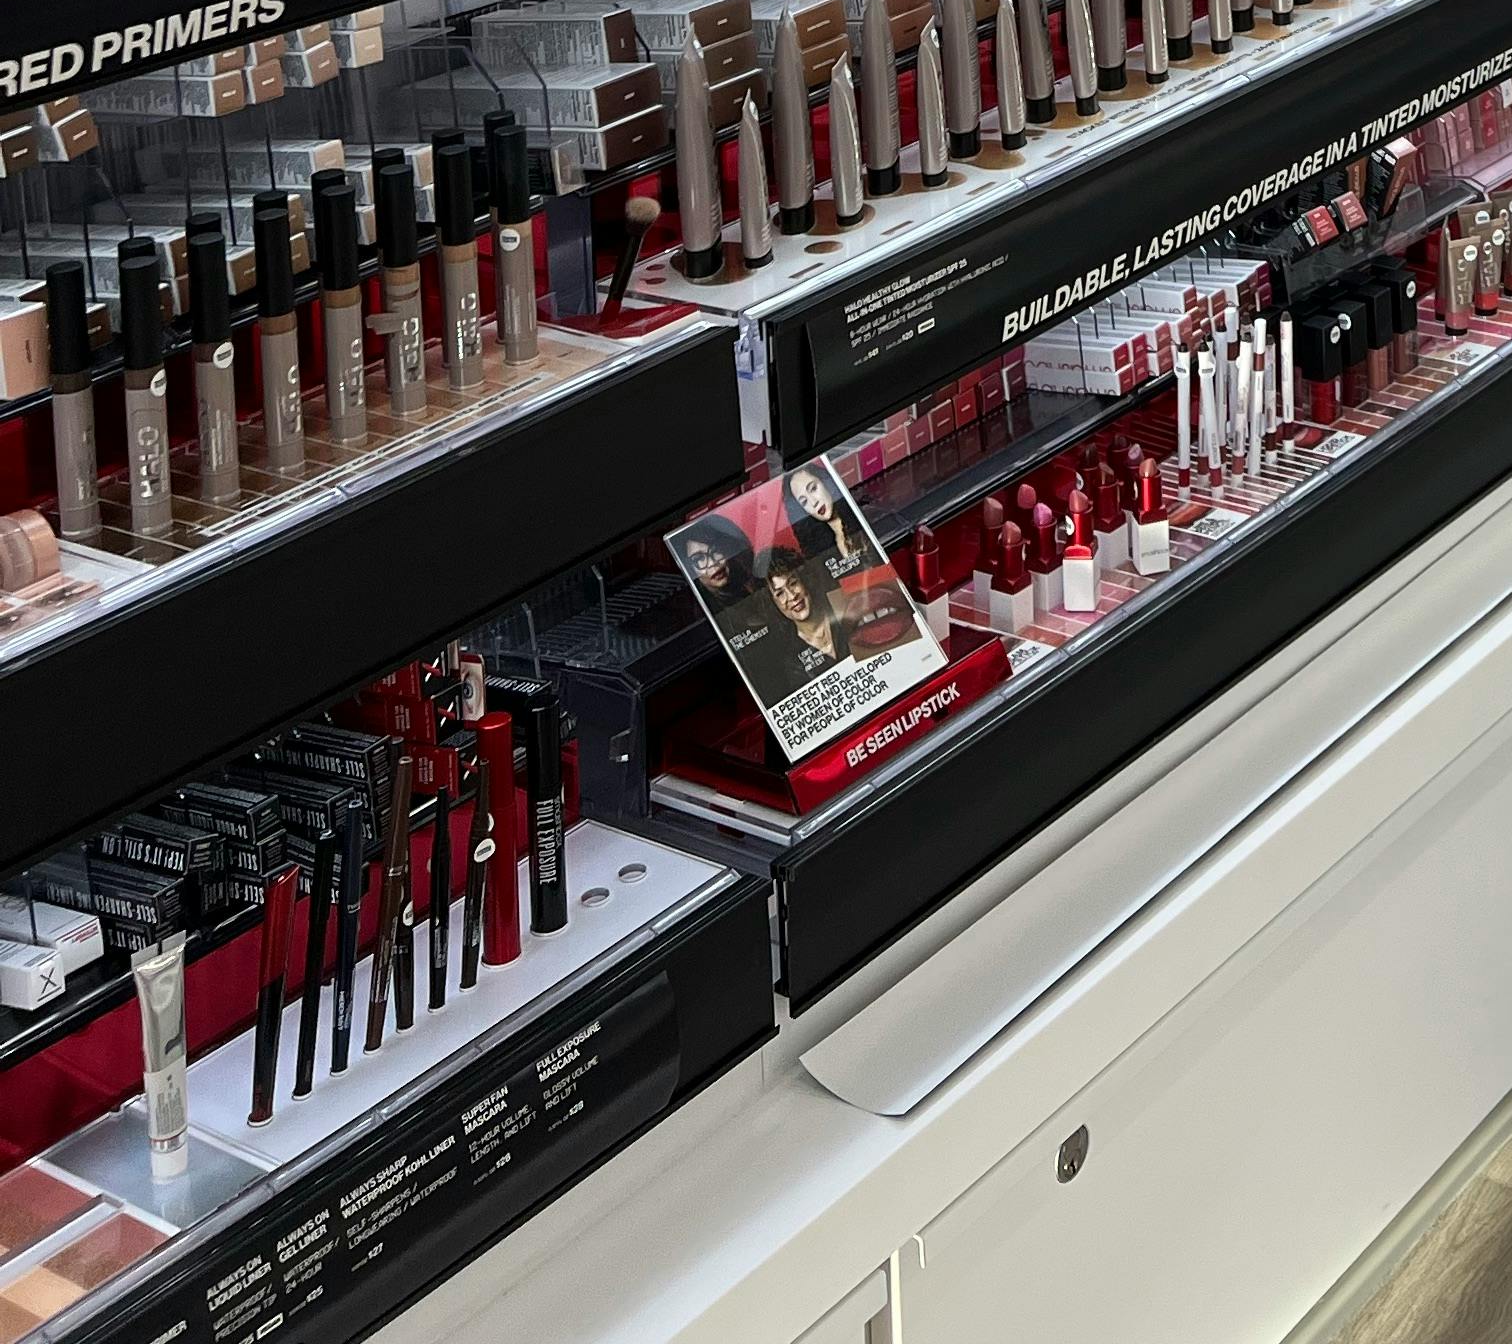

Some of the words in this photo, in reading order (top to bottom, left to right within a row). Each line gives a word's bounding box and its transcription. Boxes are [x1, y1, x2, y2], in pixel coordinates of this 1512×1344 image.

[1002, 252, 1130, 343] BUILDABLE,
[1132, 204, 1222, 264] LASTING
[1223, 149, 1324, 221] COVERAGE
[1324, 137, 1344, 168] IN
[1343, 131, 1357, 157] A
[1360, 98, 1421, 149] TINTED
[771, 708, 780, 720] A
[779, 679, 822, 716] PERFECT
[820, 671, 841, 693] RED
[776, 699, 820, 729] CREATED
[820, 685, 840, 708] AND
[840, 653, 892, 691] DEVELOPED
[782, 723, 797, 740] BY
[795, 703, 832, 732] WOMEN
[831, 694, 846, 710] OF
[844, 677, 878, 704] COLOR
[788, 729, 809, 750] FOR
[808, 709, 844, 740] PEOPLE
[843, 702, 858, 717] OF
[856, 680, 889, 710] COLOR
[846, 742, 868, 768] BE
[867, 721, 904, 754] SEEN
[902, 682, 961, 732] LIPSTICK
[536, 799, 554, 826] FULL
[537, 828, 558, 886] EXPOSURE
[535, 1051, 558, 1073] FULL
[556, 1020, 602, 1057] EXPOSURE
[538, 1048, 581, 1083] MASCARA
[461, 1096, 491, 1124] SUPER
[490, 1085, 509, 1104] FAN
[464, 1100, 508, 1136] MASCARA
[339, 1177, 377, 1209] ALWAYS
[375, 1155, 408, 1183] SHARP
[342, 1171, 407, 1220] WATERPROOF
[405, 1153, 430, 1178] KOHL
[429, 1135, 456, 1162] LINER
[276, 1218, 316, 1254] ALWAYS
[314, 1208, 330, 1227] ON
[278, 1244, 301, 1264] GEL
[300, 1224, 328, 1251] LINER
[206, 1266, 247, 1301] ALWAYS
[245, 1255, 263, 1273] ON
[208, 1284, 242, 1313] LIQUID
[242, 1262, 272, 1289] LINER
